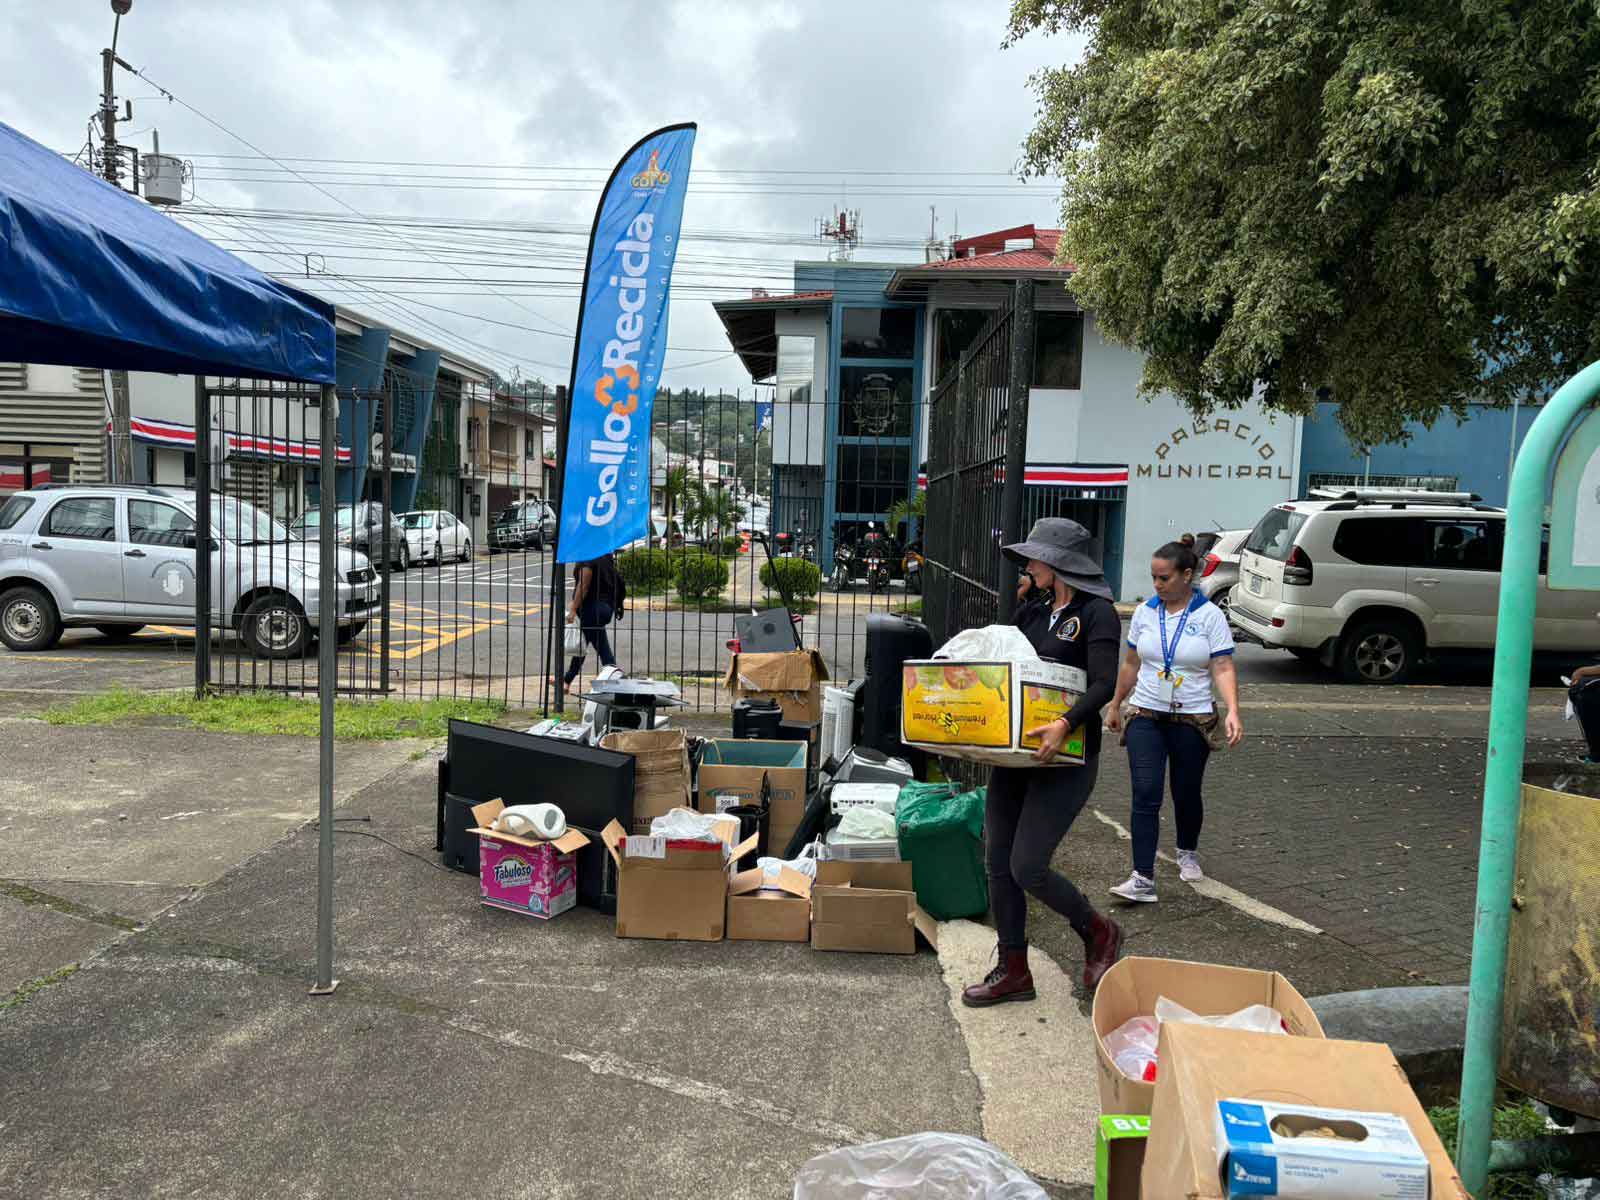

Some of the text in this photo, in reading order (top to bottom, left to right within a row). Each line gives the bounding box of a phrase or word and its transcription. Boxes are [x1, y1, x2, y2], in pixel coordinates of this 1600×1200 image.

[602, 212, 654, 371] Recicla
[1155, 418, 1275, 460] PALACIO
[1136, 464, 1292, 480] MUNICIPAL
[494, 863, 532, 881] Fabuloso
